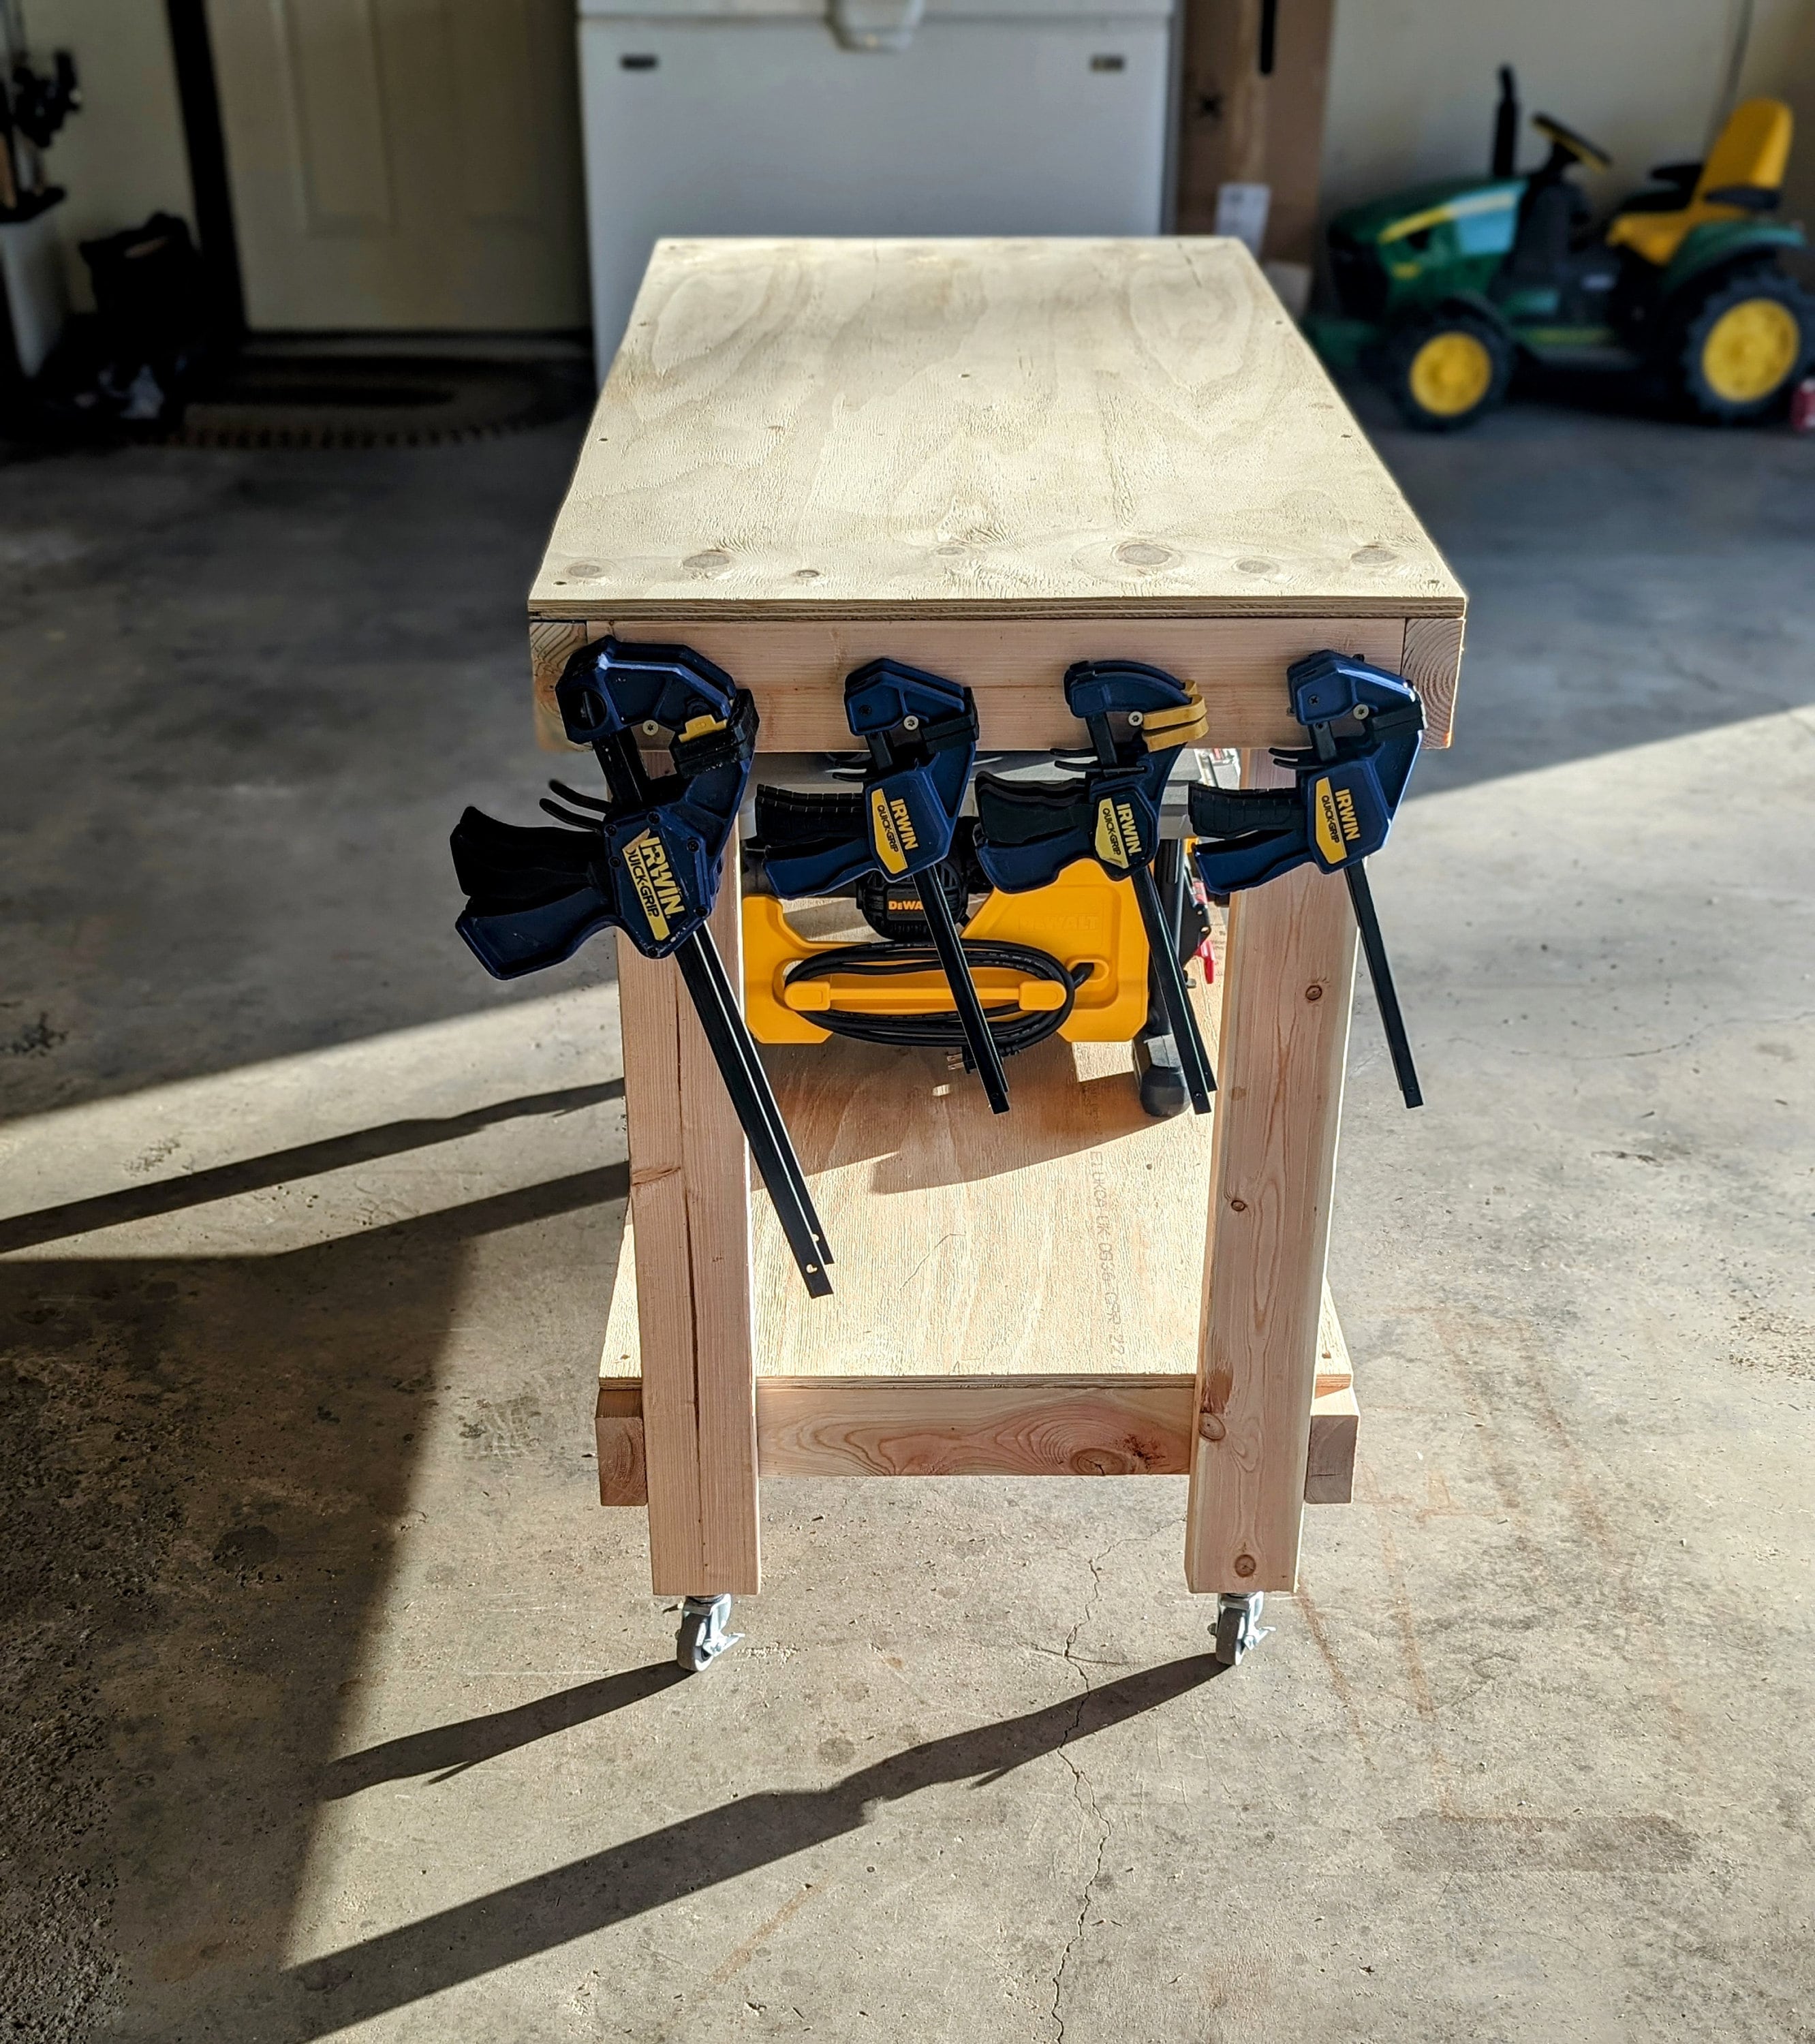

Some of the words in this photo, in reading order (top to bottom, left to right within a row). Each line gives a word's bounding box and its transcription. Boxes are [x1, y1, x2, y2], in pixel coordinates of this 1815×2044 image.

[890, 798, 919, 850] IRWIN
[1116, 803, 1143, 854] IRWIN
[1335, 788, 1361, 841] IRWIN
[640, 837, 685, 916] IRWIN
[888, 900, 925, 910] DEWA
